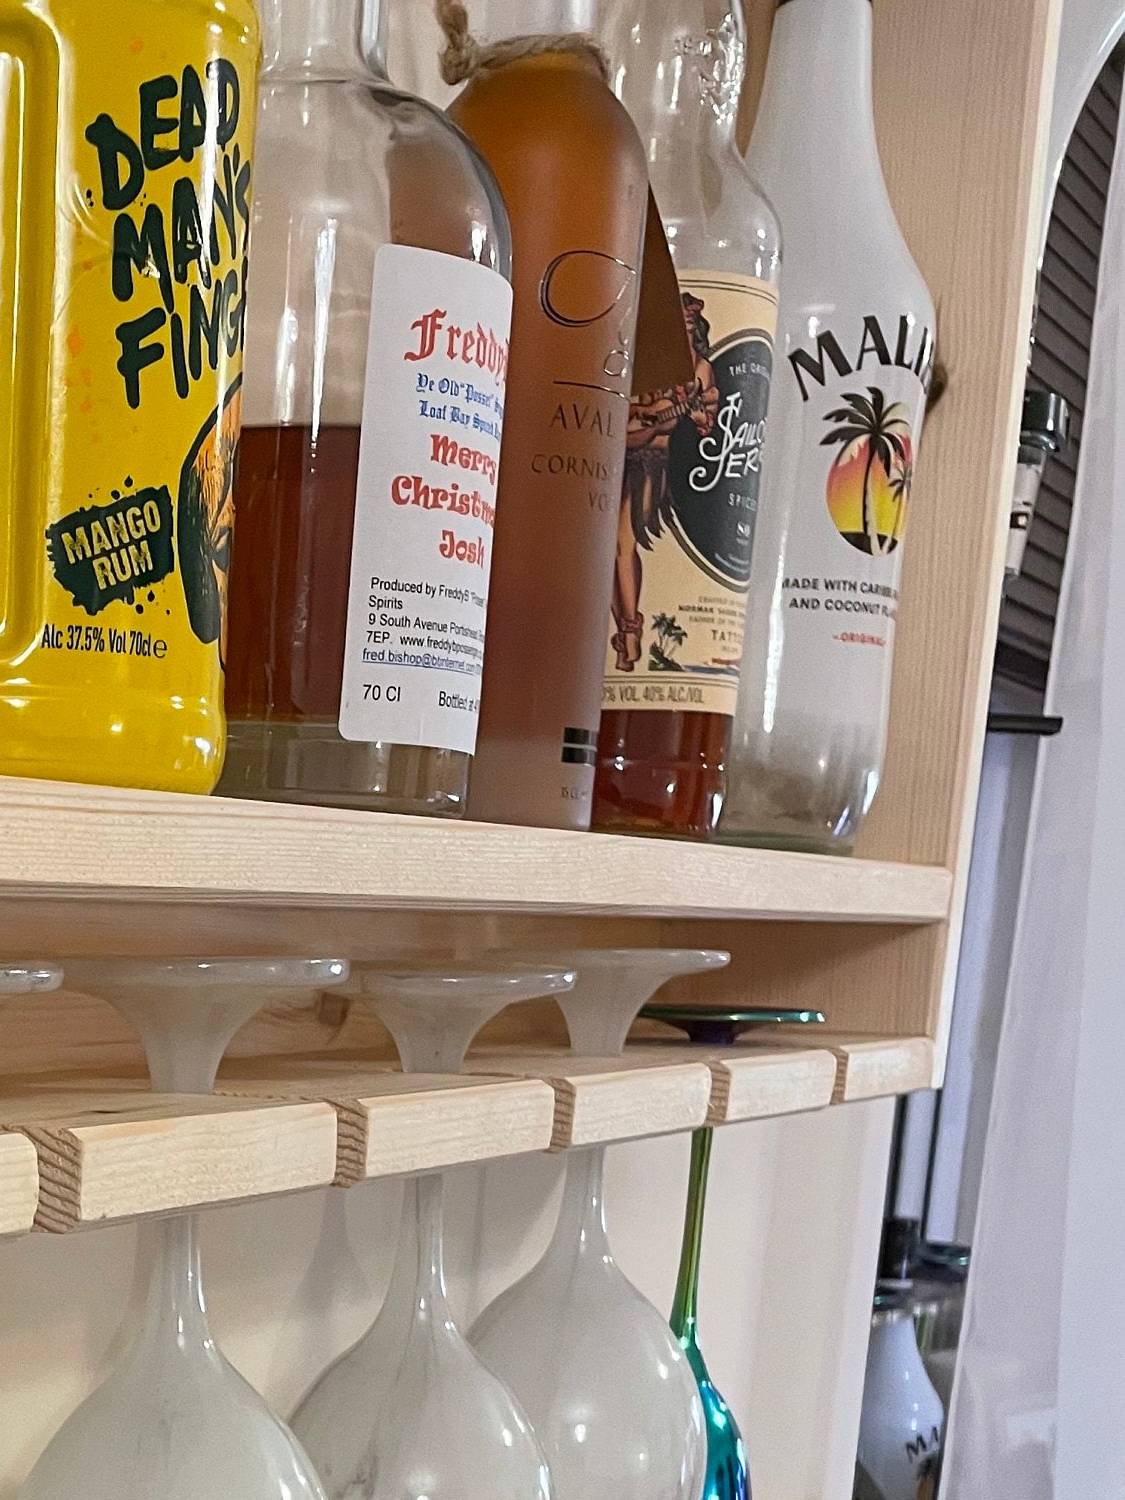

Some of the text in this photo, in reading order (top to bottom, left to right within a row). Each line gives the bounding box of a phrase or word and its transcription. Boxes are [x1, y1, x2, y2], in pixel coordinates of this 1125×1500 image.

[85, 57, 240, 211] DEAD
[115, 255, 248, 410] FING
[787, 314, 934, 403] MALI
[549, 403, 614, 438] AVAL
[688, 391, 761, 492] JER
[430, 433, 497, 486] Merry
[531, 453, 609, 481] CORNIS
[61, 500, 162, 565] MANGO
[439, 529, 485, 570] Josh
[92, 540, 154, 591] RUM
[369, 595, 404, 611] Spirits
[371, 577, 423, 595] Produced
[425, 582, 437, 598] by
[781, 578, 820, 591] MADE
[824, 578, 858, 593] WITH
[368, 613, 376, 626] 9
[379, 614, 411, 628] South
[413, 616, 448, 633] Avenue
[789, 598, 821, 611] AND
[824, 598, 880, 616] COCONUT
[41, 623, 63, 650] Alc
[67, 624, 105, 653] 37.5%
[108, 628, 126, 654] Vol
[363, 684, 381, 700] 70
